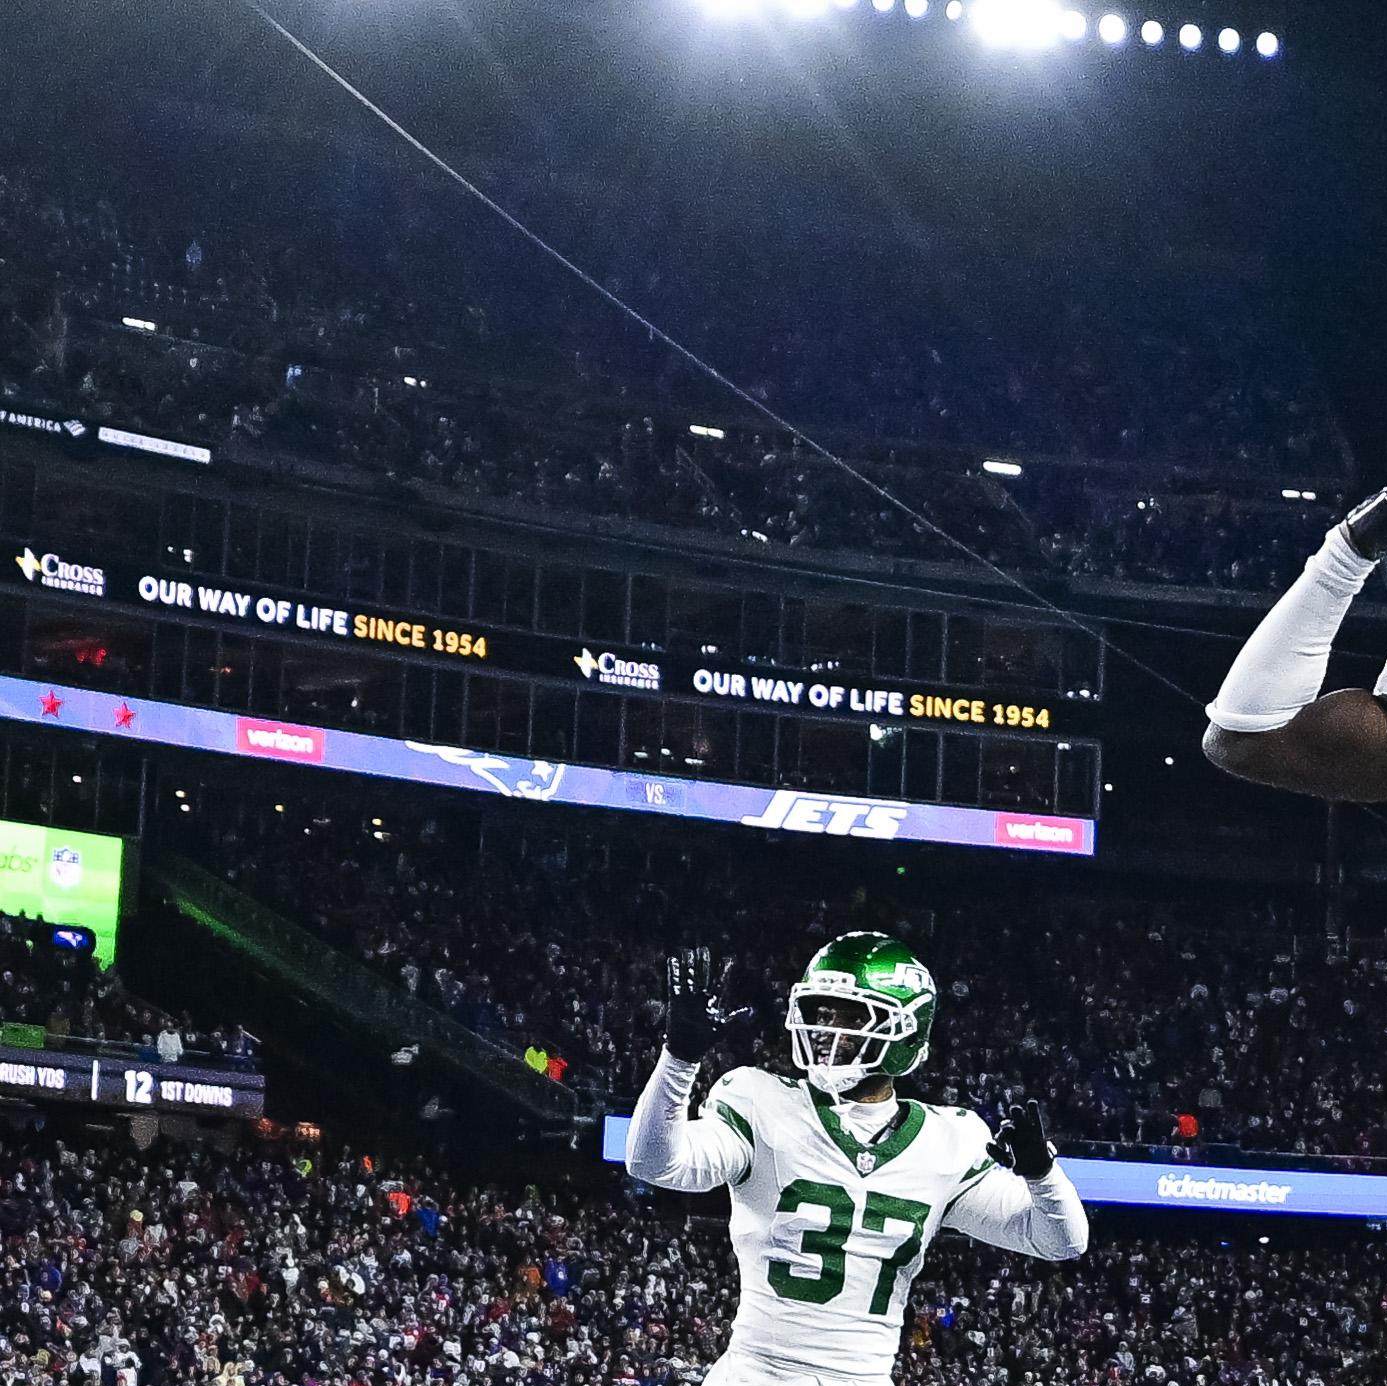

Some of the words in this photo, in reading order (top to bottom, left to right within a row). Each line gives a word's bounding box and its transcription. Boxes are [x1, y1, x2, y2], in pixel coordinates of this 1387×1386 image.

[138, 576, 193, 609] OUR
[199, 586, 251, 618] WAY
[255, 597, 290, 624] OF
[296, 604, 348, 636] LIFE
[353, 614, 426, 650] SINCE
[432, 629, 487, 659] 1954
[693, 668, 746, 698] OUR
[752, 677, 803, 706] WAY
[808, 683, 844, 709] OF
[850, 687, 904, 716] LIFE
[909, 694, 985, 723] SINCE
[992, 702, 1051, 729] 1954
[246, 726, 314, 754] verizon
[645, 783, 666, 805] VS.
[740, 789, 910, 840] JETS
[1005, 819, 1074, 843] verizon
[0, 1066, 36, 1087] RUSH
[37, 1068, 66, 1090] YDS
[123, 1068, 154, 1104] 12
[185, 1081, 234, 1108] DOWNS
[1156, 1174, 1293, 1206] ticketmaster
[768, 1178, 929, 1315] 37
